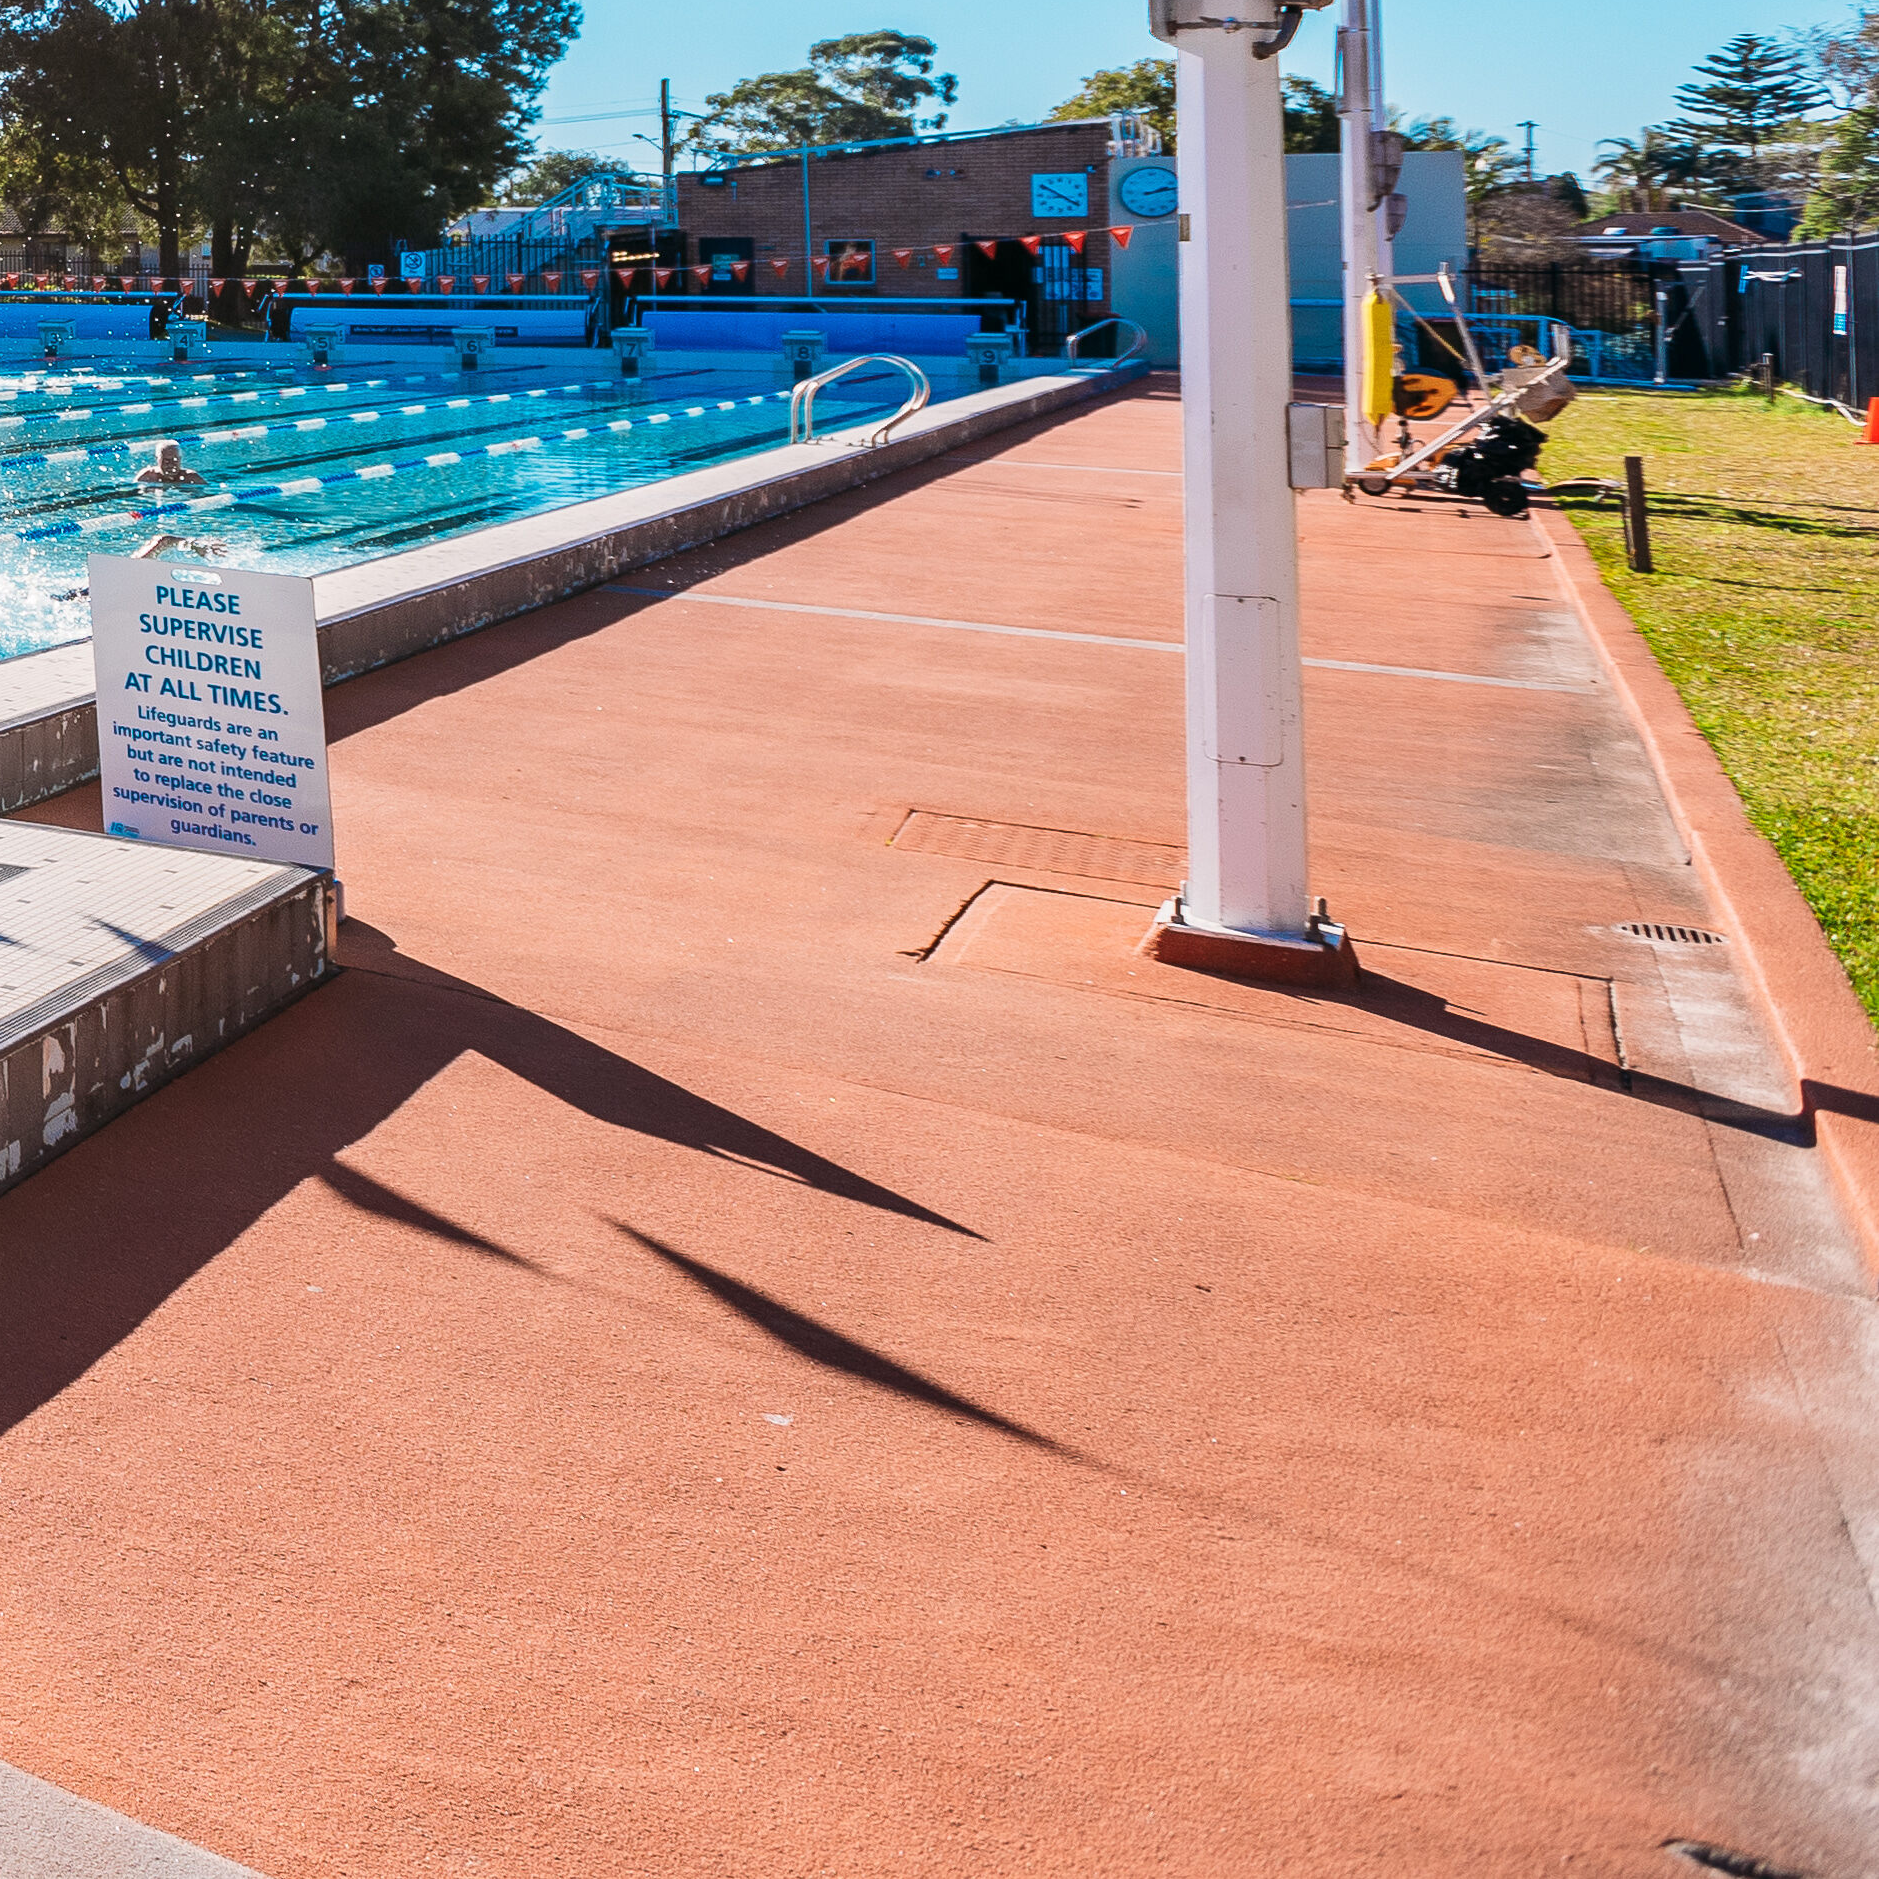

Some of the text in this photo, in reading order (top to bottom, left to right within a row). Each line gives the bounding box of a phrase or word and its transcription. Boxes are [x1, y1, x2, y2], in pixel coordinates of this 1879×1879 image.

[180, 334, 188, 346] 4
[317, 337, 328, 348] 5
[467, 340, 477, 352] 6
[626, 343, 636, 355] 7
[797, 346, 810, 359] 8
[983, 350, 995, 362] 9
[156, 585, 241, 615] PLEASE
[139, 613, 263, 649] SUPERVISE
[145, 645, 261, 680] CHILDREN
[124, 672, 289, 715] AT ALL TIMES.
[138, 705, 278, 741] Lifeguards are an
[113, 721, 315, 769] important safety feature
[127, 744, 297, 788] but are not intended
[133, 768, 292, 809] to replace the close
[113, 786, 319, 835] supervision of parents or
[170, 819, 257, 846] guardians.
